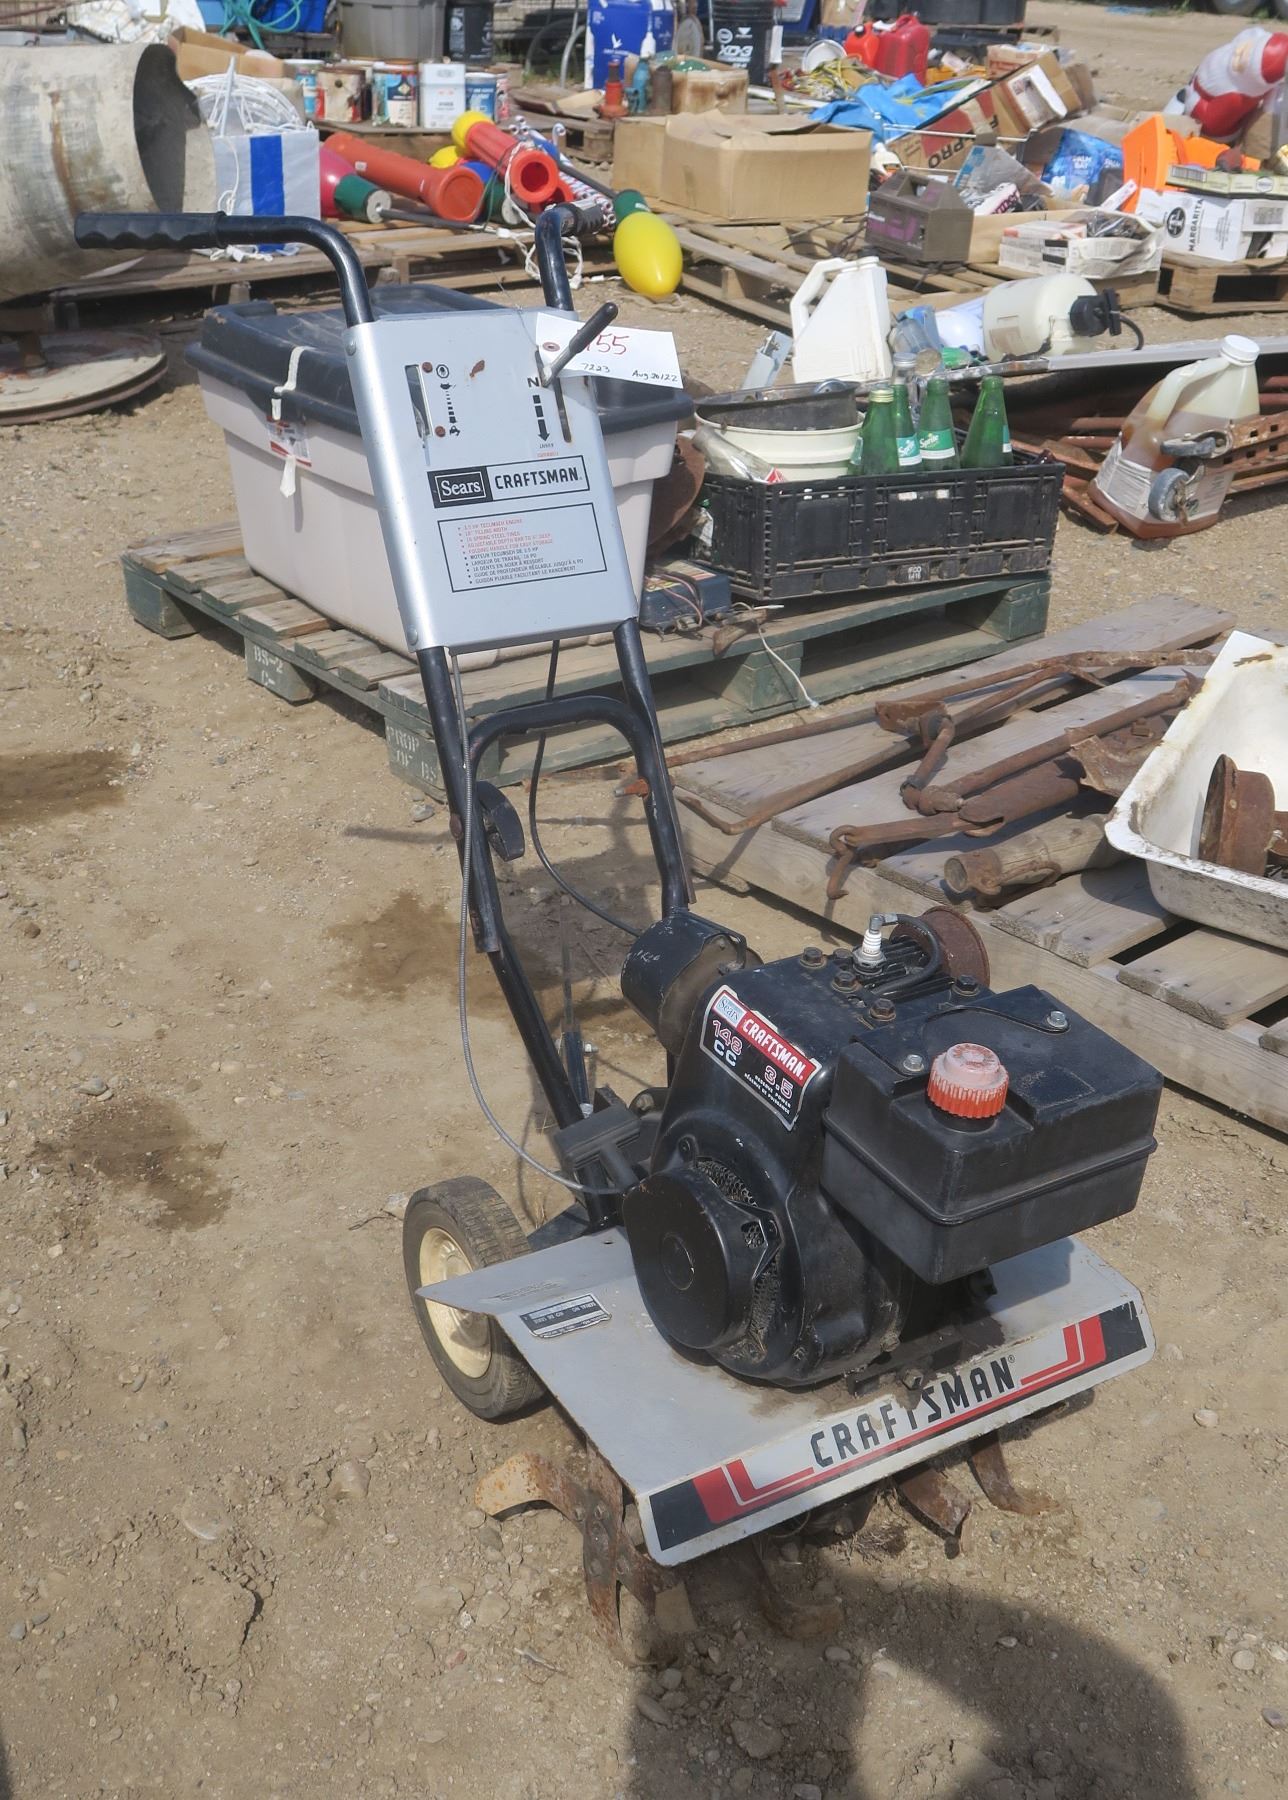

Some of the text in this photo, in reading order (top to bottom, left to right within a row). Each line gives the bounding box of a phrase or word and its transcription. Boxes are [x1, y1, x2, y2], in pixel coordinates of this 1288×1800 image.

[928, 114, 998, 169] F-PRO
[1189, 199, 1204, 252] MARGARITA
[586, 333, 630, 355] 55
[527, 377, 540, 387] N
[919, 433, 938, 449] Sprite
[440, 467, 578, 496] Sears CRAFTSMAN
[718, 998, 739, 1021] Sears
[714, 1039, 737, 1067] CC
[764, 1065, 794, 1099] 3.5
